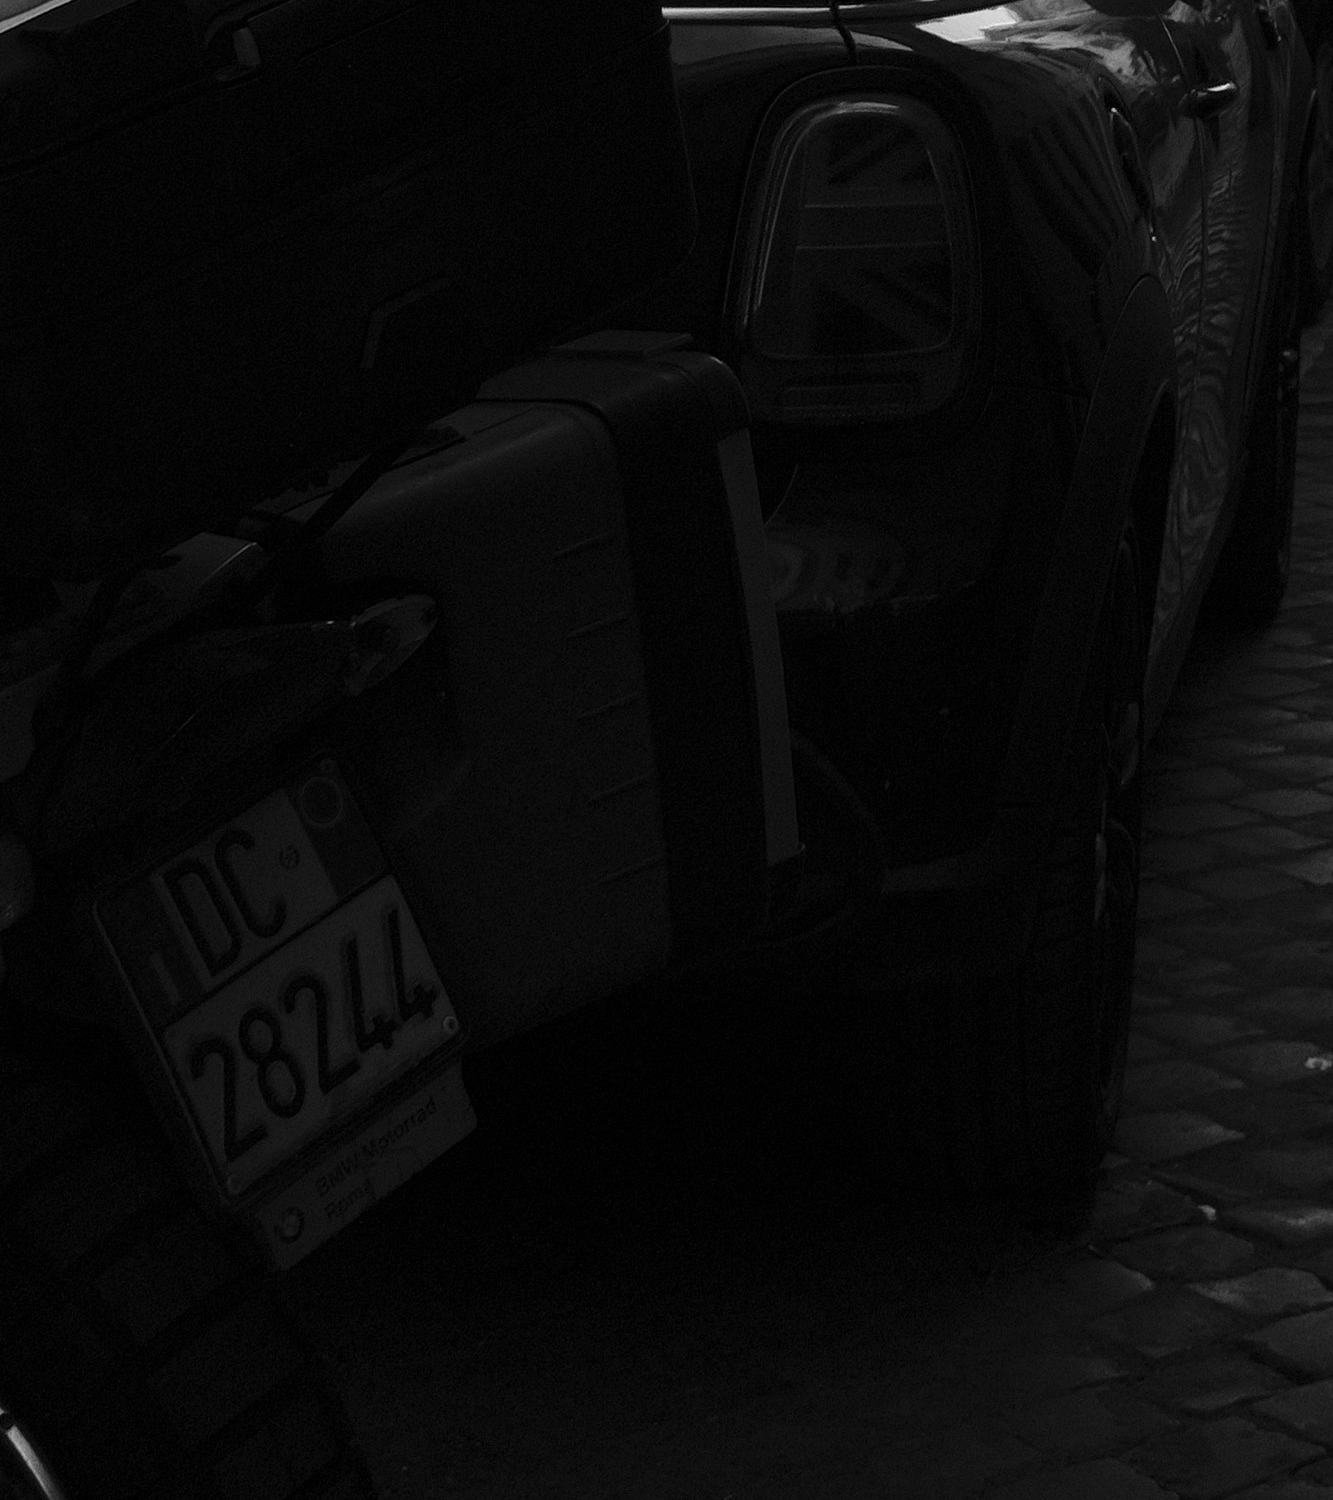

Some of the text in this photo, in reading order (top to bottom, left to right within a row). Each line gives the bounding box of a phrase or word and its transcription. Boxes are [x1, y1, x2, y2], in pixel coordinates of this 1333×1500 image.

[162, 828, 287, 976] DC
[189, 908, 439, 1162] 28244
[314, 1095, 438, 1198] BMW Motorrad
